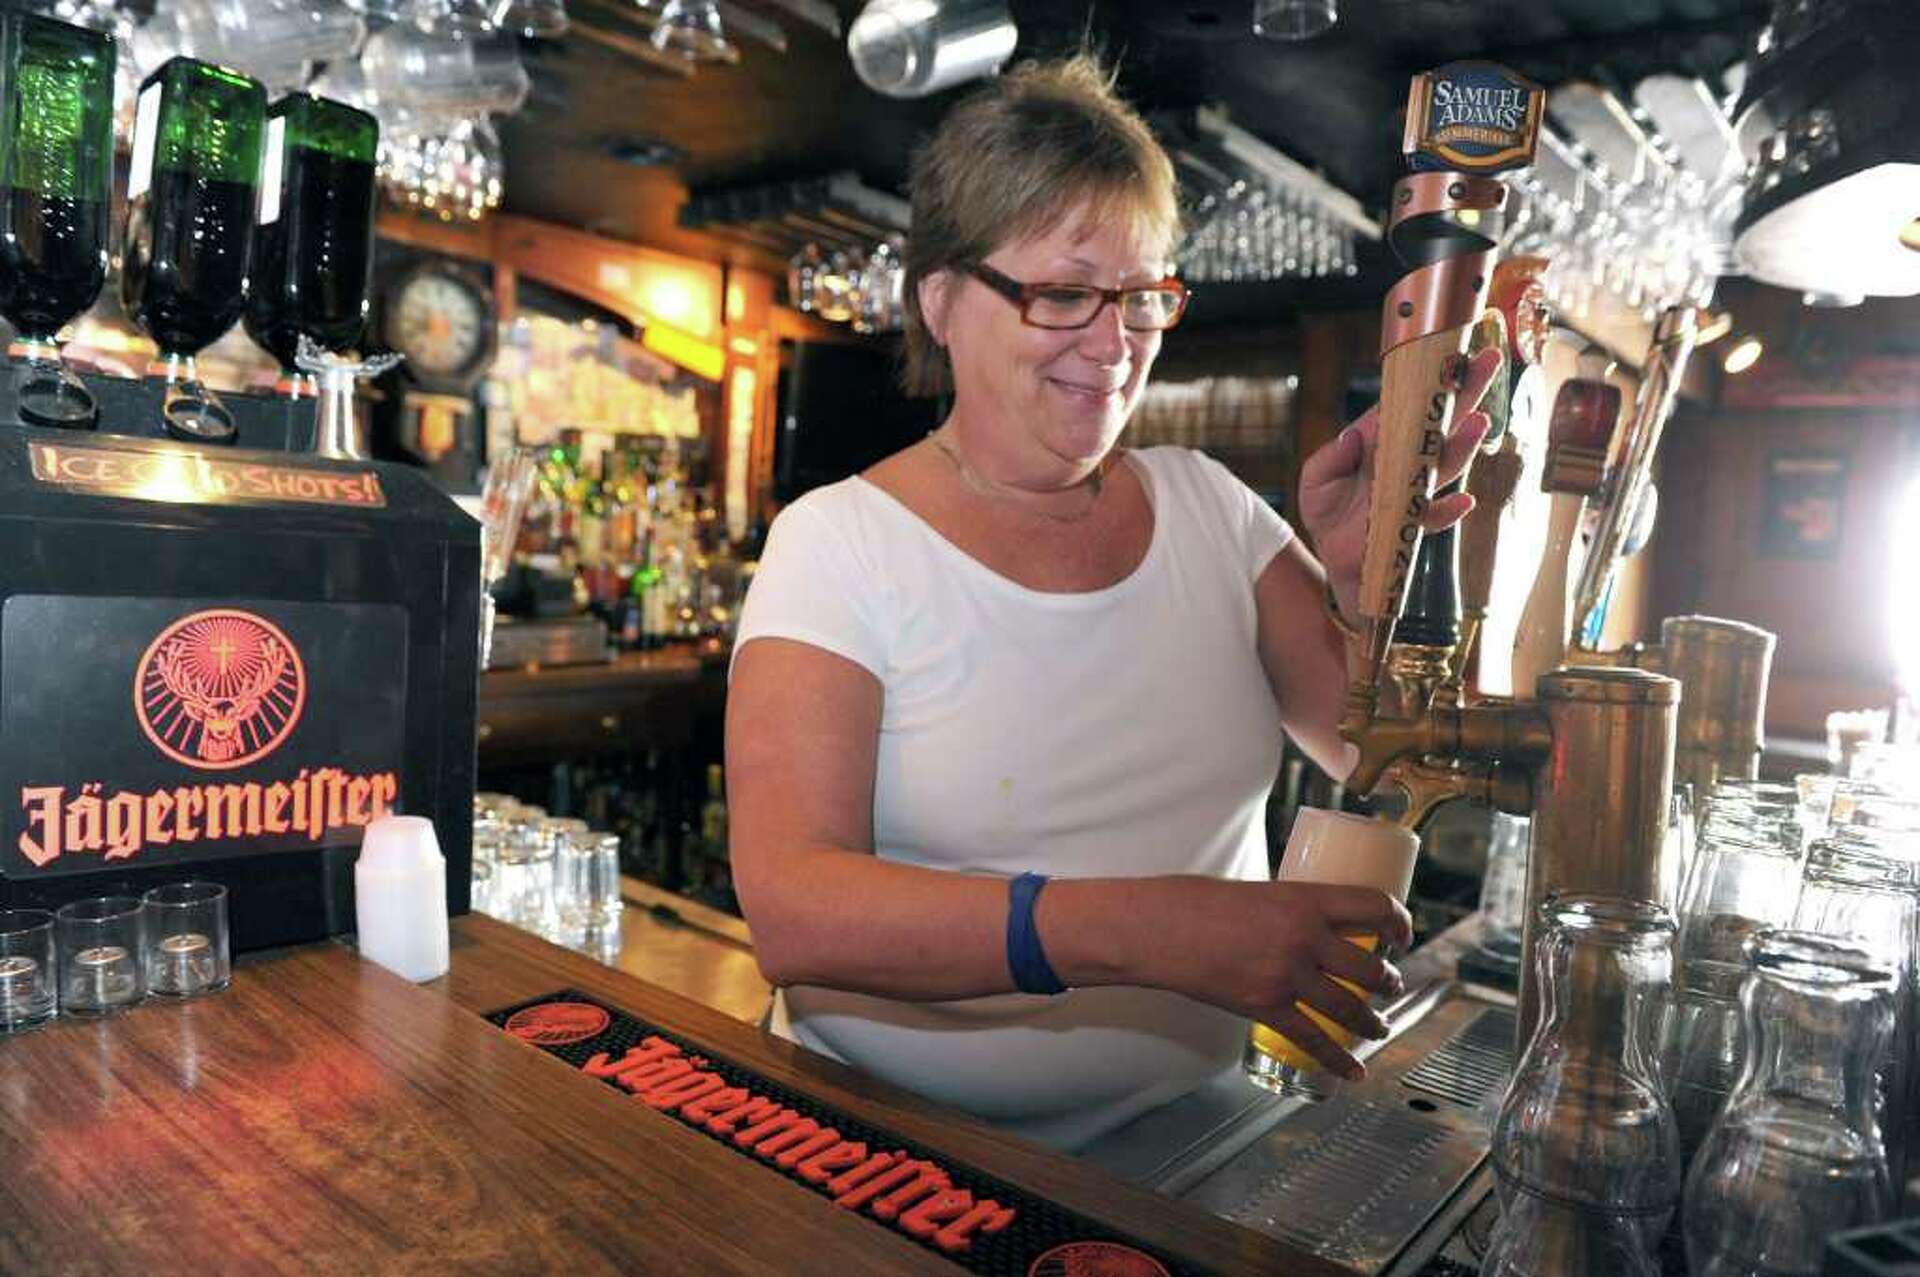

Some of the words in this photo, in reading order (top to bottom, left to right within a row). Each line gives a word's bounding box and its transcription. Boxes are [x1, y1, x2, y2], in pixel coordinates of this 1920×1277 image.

[1434, 80, 1525, 112] SAMUEL
[1439, 104, 1517, 131] ADAMS
[45, 447, 119, 482] ICE
[20, 768, 396, 866] Jägermeister
[581, 1035, 1017, 1252] Jägermeister
